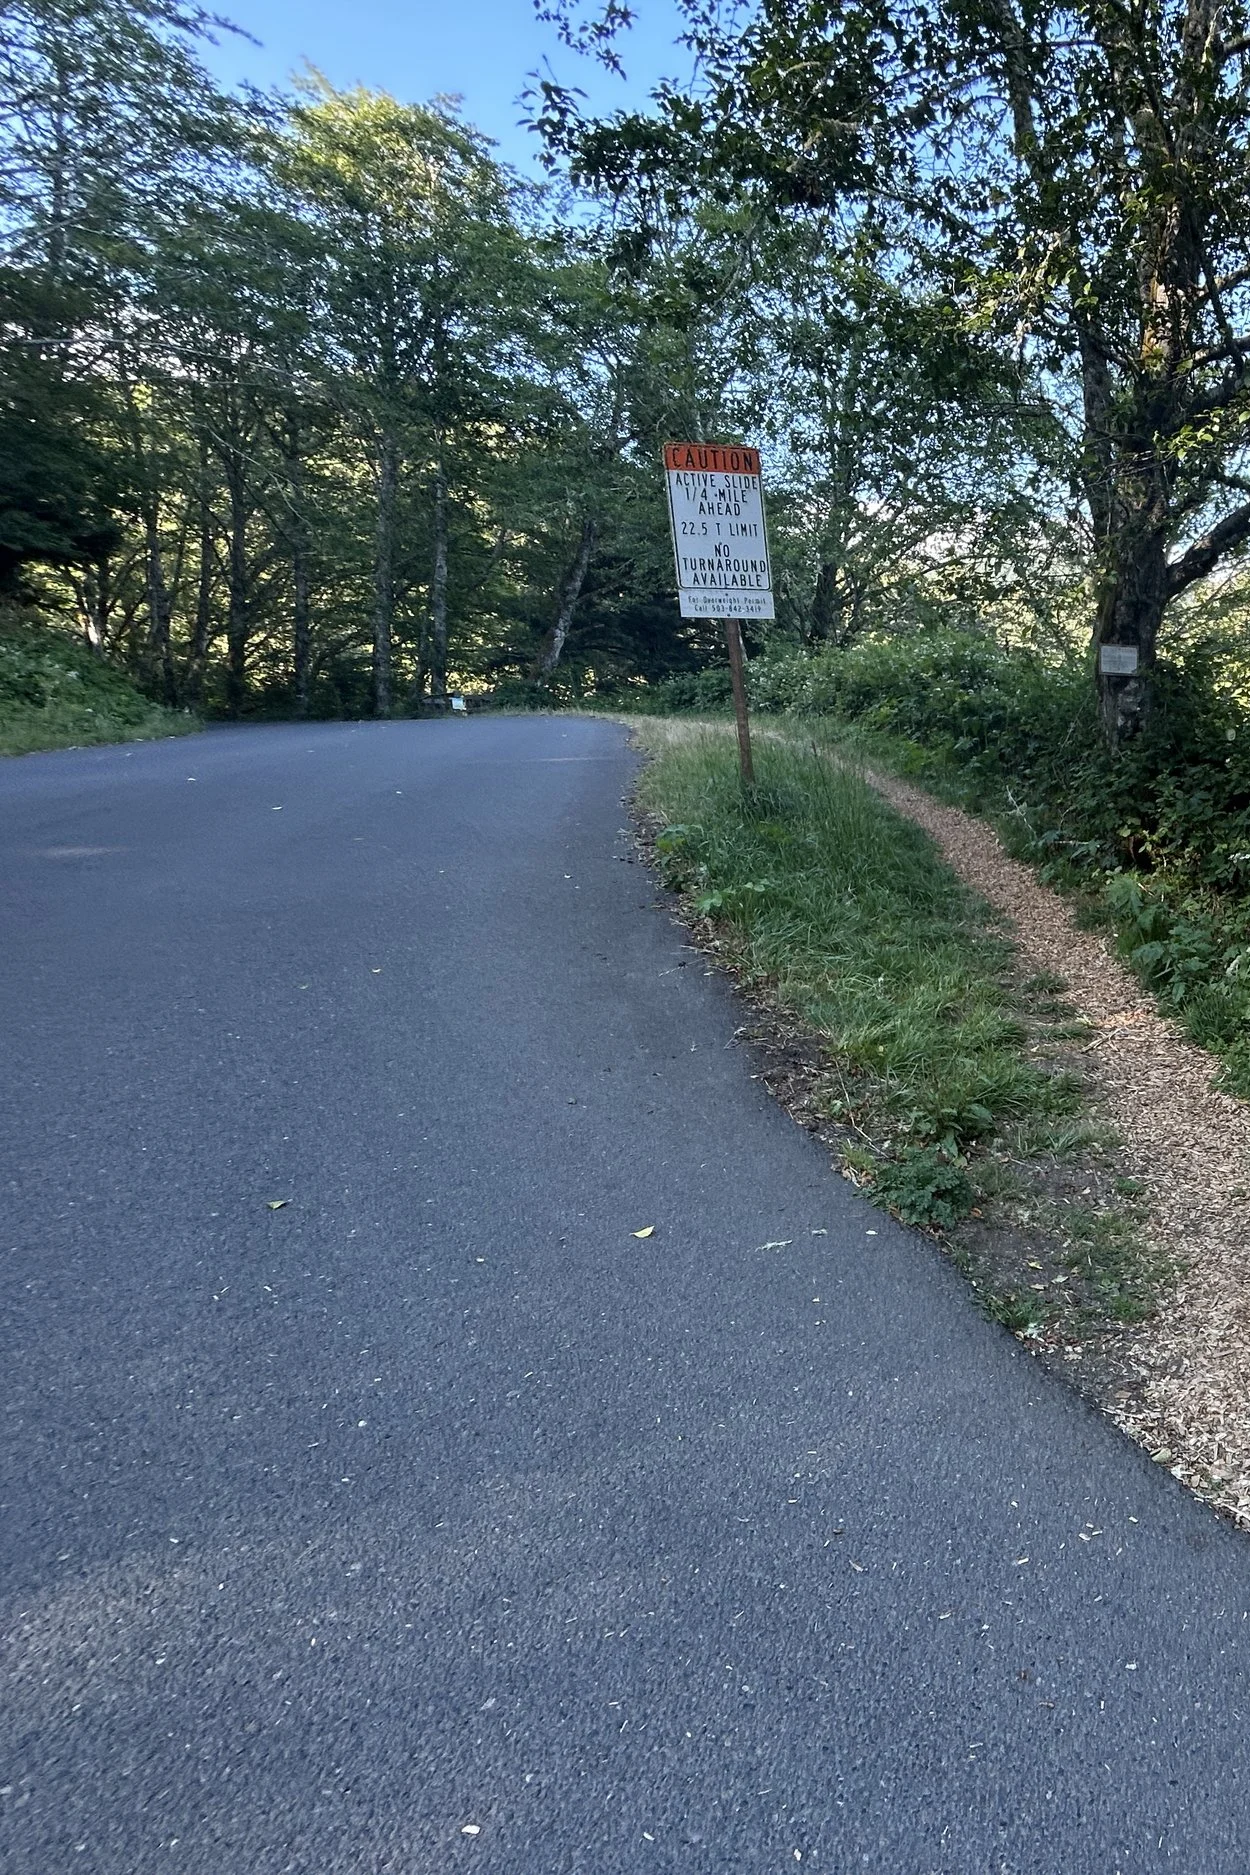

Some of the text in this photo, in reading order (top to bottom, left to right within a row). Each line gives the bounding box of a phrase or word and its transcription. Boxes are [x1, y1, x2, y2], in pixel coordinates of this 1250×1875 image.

[672, 447, 753, 471] CAUTION
[675, 472, 758, 490] ACTIVE SLIDE
[685, 487, 748, 503] 1/4 MILE
[698, 501, 741, 516] AHEAD
[681, 521, 758, 537] 22.5 T LIMIT
[714, 544, 730, 557] NO
[682, 557, 766, 573] TURNAROUND
[692, 572, 763, 587] AVAILABLE
[688, 595, 766, 605] For Overweight Permit
